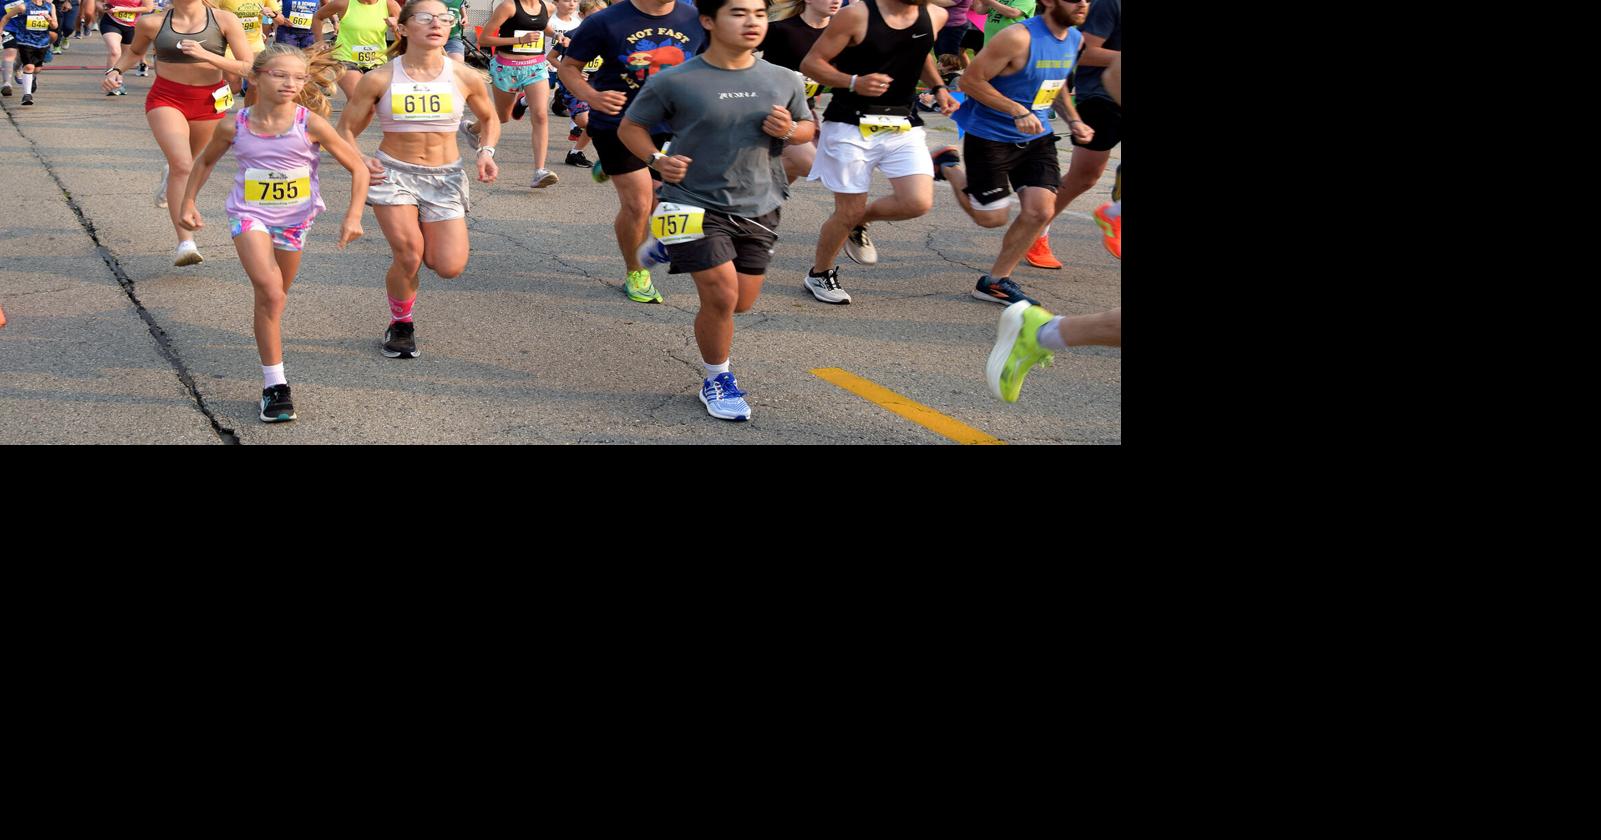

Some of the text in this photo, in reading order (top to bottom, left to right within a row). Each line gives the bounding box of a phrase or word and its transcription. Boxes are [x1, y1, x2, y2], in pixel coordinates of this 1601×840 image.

[31, 20, 46, 28] 643
[242, 22, 254, 30] 99
[292, 16, 308, 26] 667
[626, 27, 690, 44] NOT FAST
[404, 95, 440, 113] 616
[258, 180, 298, 200] 755
[658, 214, 689, 237] 757
